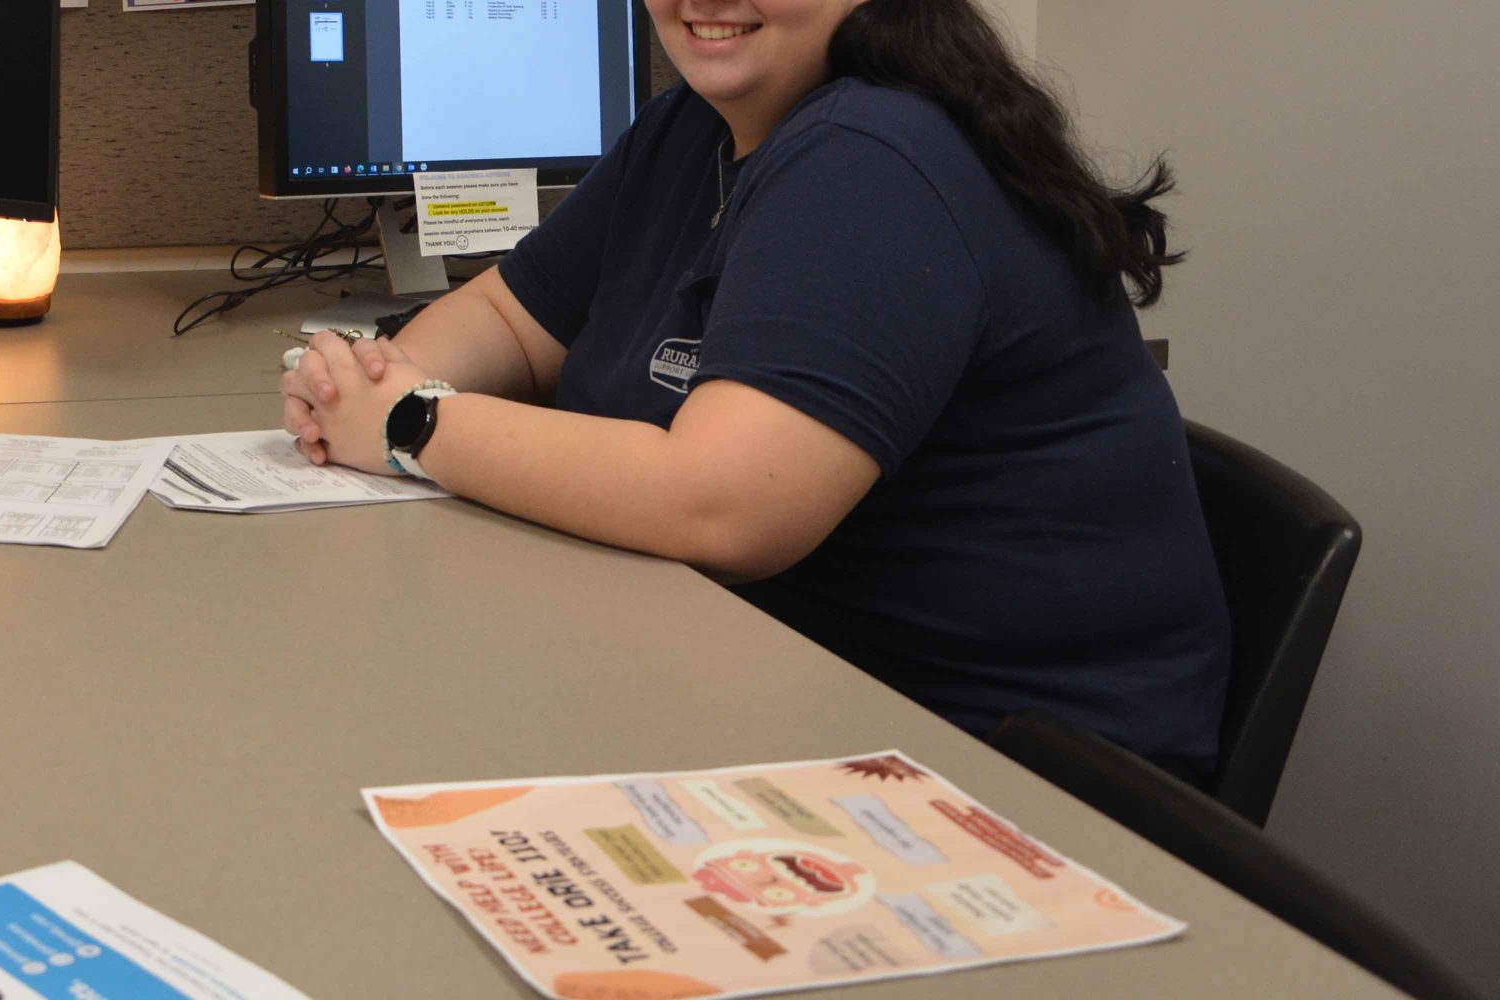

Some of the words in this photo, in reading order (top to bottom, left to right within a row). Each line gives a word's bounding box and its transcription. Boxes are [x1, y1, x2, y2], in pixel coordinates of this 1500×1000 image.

[654, 363, 685, 376] SUPPORT
[660, 347, 701, 369] RURA
[490, 830, 548, 864] 110!
[456, 879, 509, 916] HELP
[500, 884, 580, 946] COLLEGE
[496, 916, 551, 955] NEED
[577, 914, 650, 966] TAKE
